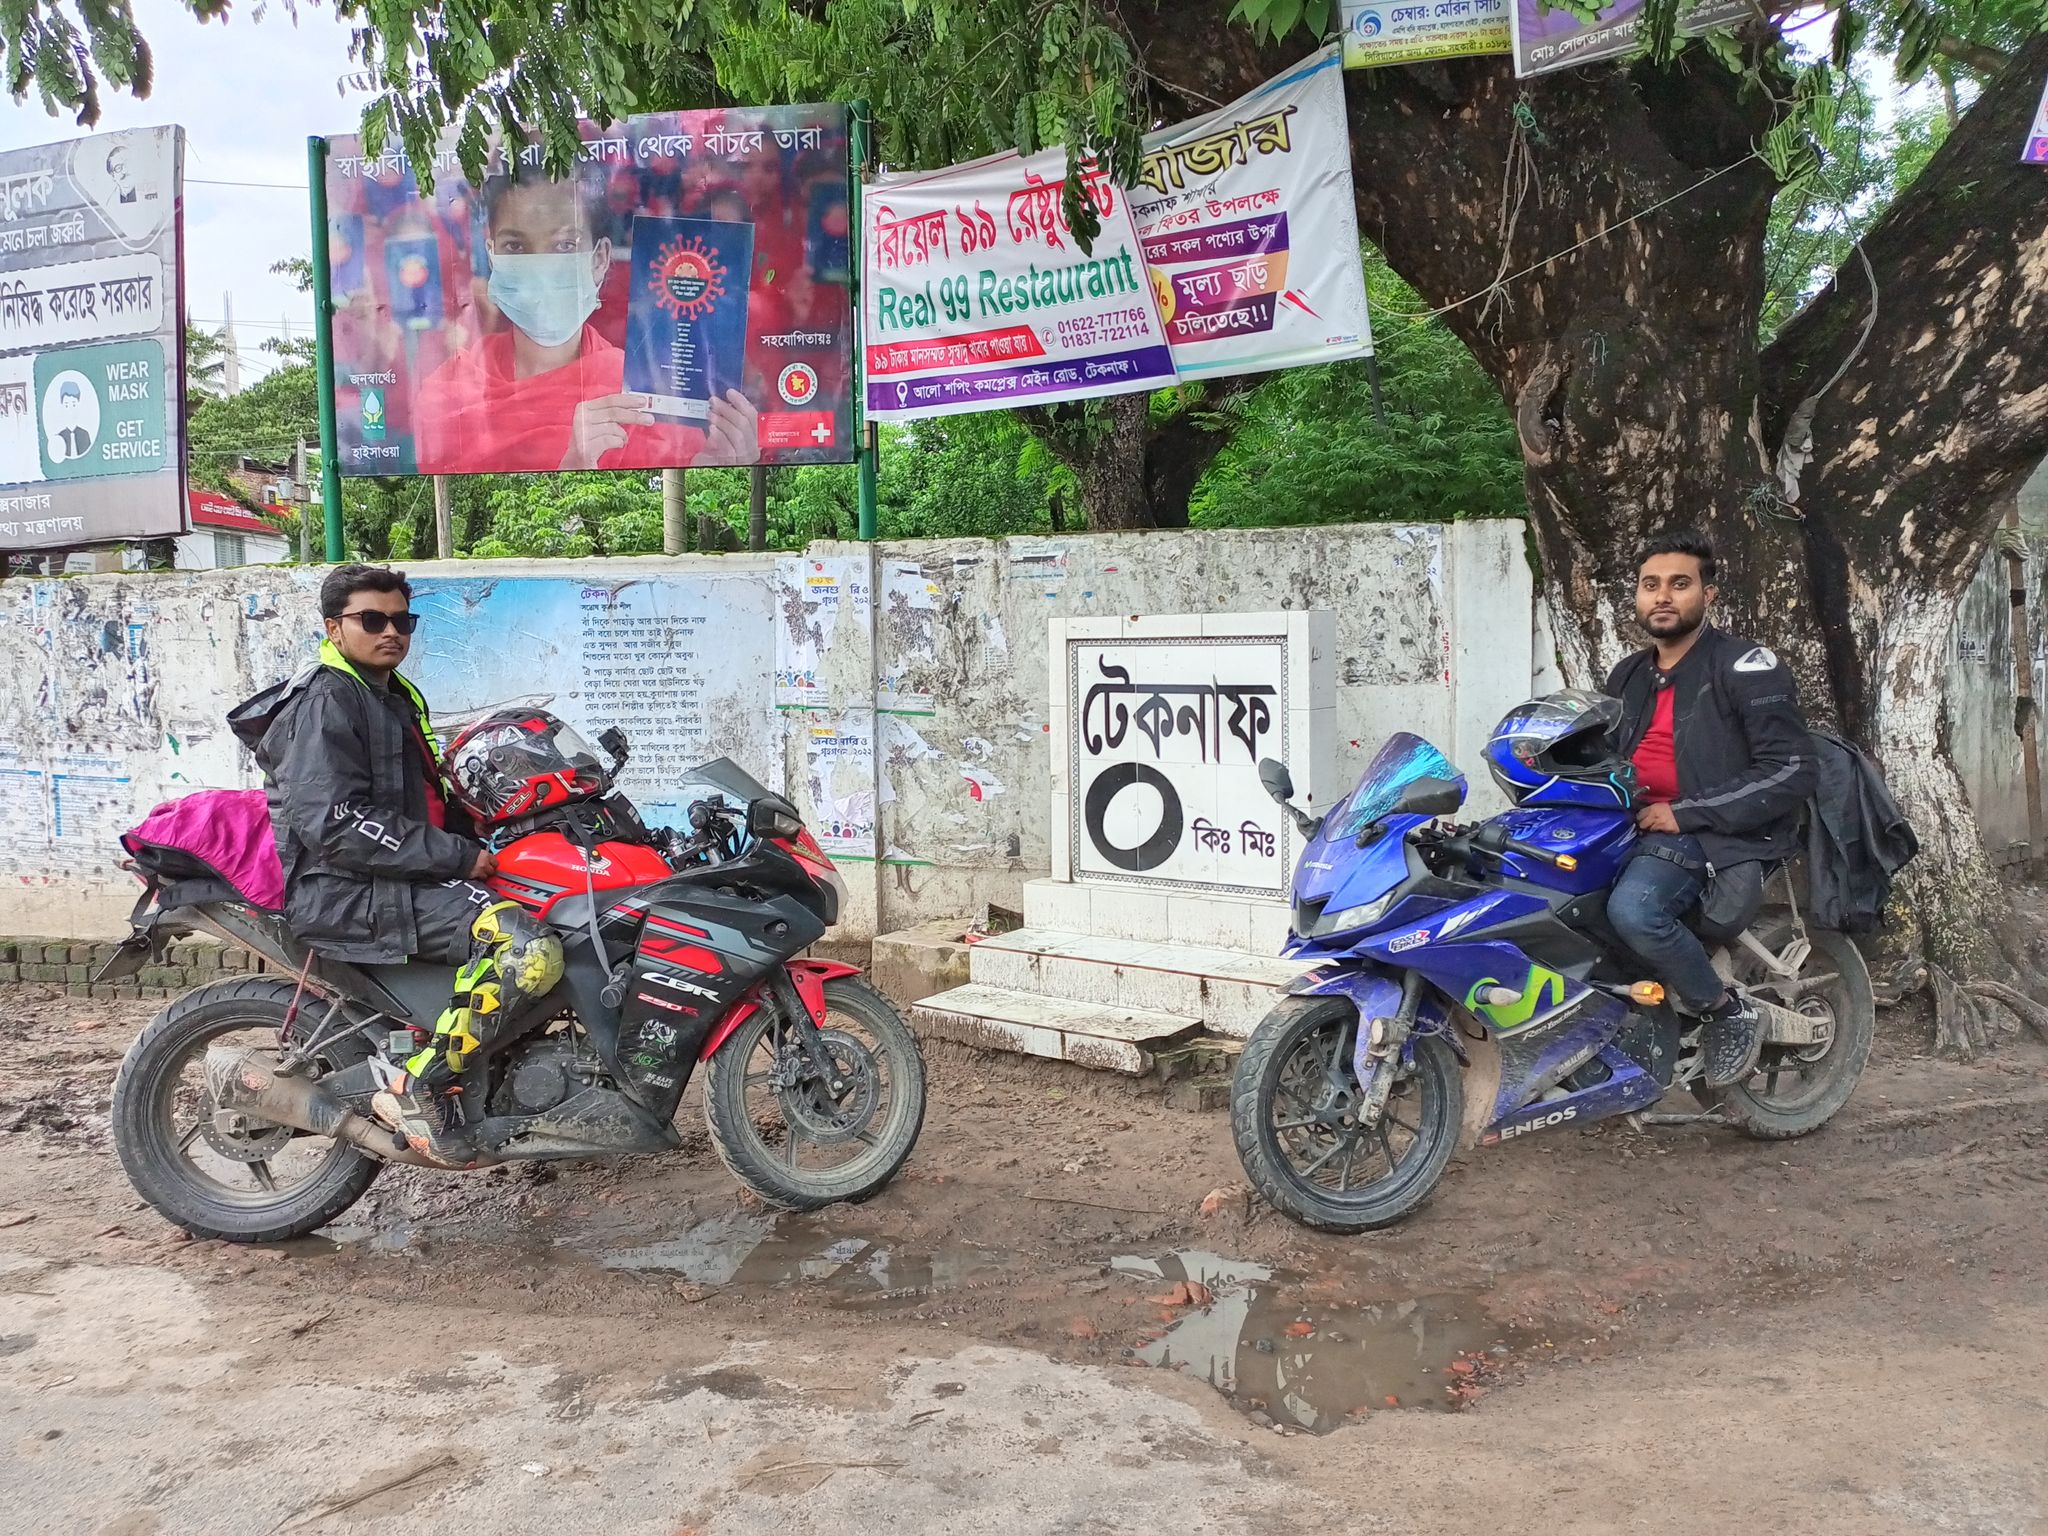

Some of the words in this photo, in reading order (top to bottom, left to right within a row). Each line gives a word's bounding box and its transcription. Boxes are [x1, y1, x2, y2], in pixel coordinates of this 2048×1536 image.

[1392, 6, 1429, 22] চেম্বার:
[1530, 46, 1554, 62] মোঃ
[1558, 30, 1608, 54] সোলতান
[577, 136, 627, 162] রোনা
[638, 133, 693, 159] থেকে
[702, 125, 765, 155] বাঁচবে
[773, 125, 822, 151] তারা
[1205, 188, 1280, 218] উপলক্ষে
[26, 226, 48, 248] চলা
[50, 212, 85, 244] জরুরি
[874, 205, 950, 271] রিয়েল
[956, 199, 997, 254] ৯৯
[1170, 237, 1201, 256] সকল
[1205, 230, 1244, 249] পণ্যের
[1248, 222, 1277, 241] উপর
[46, 282, 98, 323] করেছে
[100, 271, 153, 316] সরকার
[879, 280, 937, 332] Real
[940, 273, 970, 322] 99
[979, 243, 1139, 318] Restaurant
[1177, 271, 1223, 306] মূল্য
[1228, 260, 1269, 291] ছাড়
[1057, 306, 1146, 334] 01622-777766
[1061, 322, 1150, 349] 01837-722114
[1173, 303, 1268, 336] চলিতেছে!!
[760, 330, 831, 348] সহযোগিতায়ঃ
[106, 360, 149, 381] WEAR
[913, 384, 941, 400] আলো
[944, 378, 971, 395] শপিং
[974, 372, 1017, 393] কমপ্লেক্স
[1021, 369, 1050, 387] মেইন
[1085, 358, 1129, 379] টেকনাফ
[108, 382, 149, 402] MASK
[116, 419, 144, 439] GET
[102, 439, 161, 461] SERVICE
[351, 444, 400, 460] হাইসাওয়া
[22, 516, 84, 537] মন্ত্রণালয়
[1083, 653, 1277, 764] টেকনাফ
[505, 791, 532, 815] SOL
[1085, 762, 1184, 871] ০
[1191, 817, 1230, 854] কিঃ
[1239, 820, 1275, 857] মিঃ
[571, 864, 611, 877] HONDA
[641, 972, 721, 1004] CBR
[1500, 1105, 1578, 1141] ENEOS
